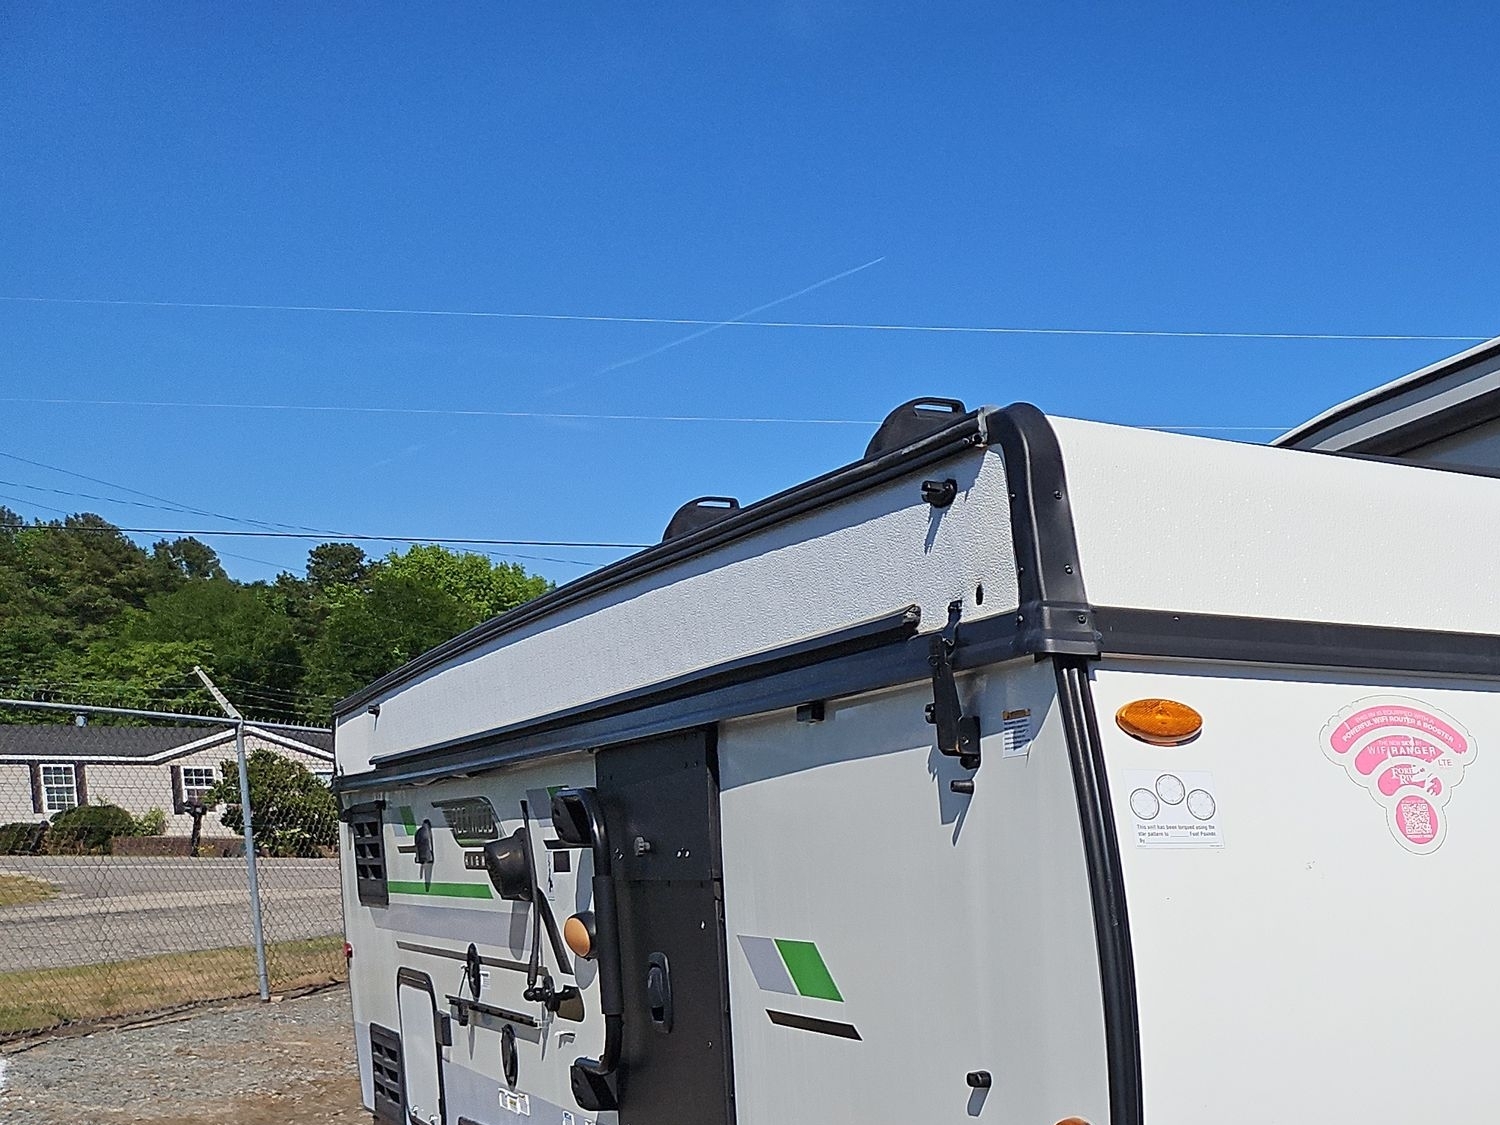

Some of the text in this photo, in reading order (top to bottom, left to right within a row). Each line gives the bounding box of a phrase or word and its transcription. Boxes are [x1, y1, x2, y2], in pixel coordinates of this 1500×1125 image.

[1342, 719, 1374, 741] POWERFUL
[1373, 715, 1389, 725] WIFI
[1389, 715, 1416, 725] ROUTER
[1423, 721, 1455, 743] BOOSTER
[1438, 759, 1453, 768] LTE
